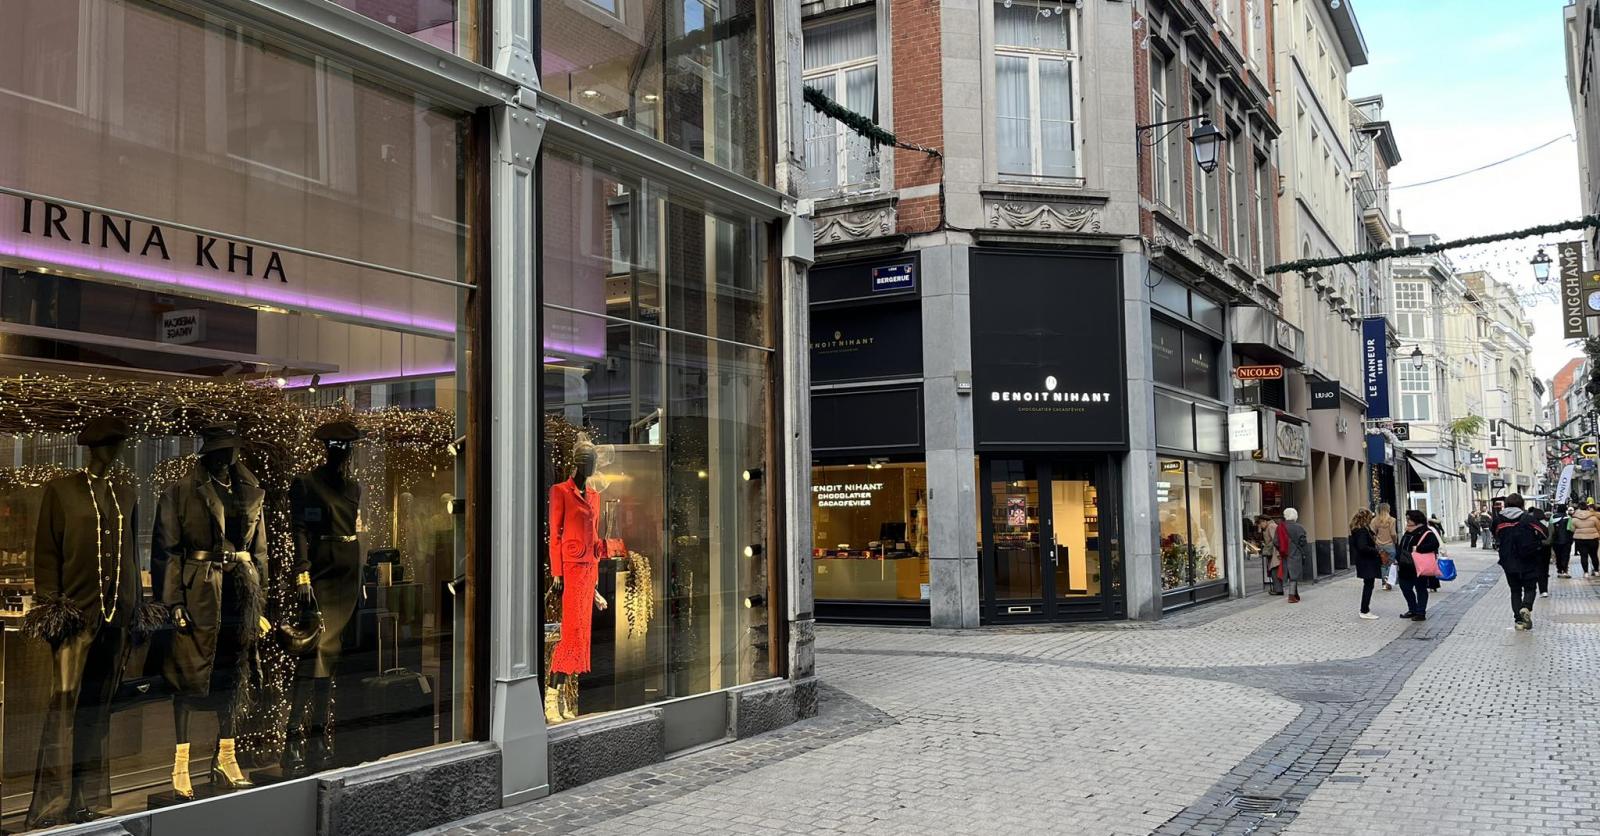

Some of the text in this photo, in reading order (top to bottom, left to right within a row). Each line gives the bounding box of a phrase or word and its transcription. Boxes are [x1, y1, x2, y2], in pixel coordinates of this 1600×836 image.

[22, 198, 288, 283] IRINA KHA
[1564, 247, 1582, 333] LONGCHAMP
[810, 337, 874, 349] ENOIT NIHANT
[1240, 368, 1280, 377] NICOLAS
[1367, 339, 1378, 397] LE TANNEUR
[991, 391, 1110, 402] BENOIT NIHANT
[811, 483, 883, 492] ENOIT NIHANT
[818, 492, 871, 500] CHOCOLATIER
